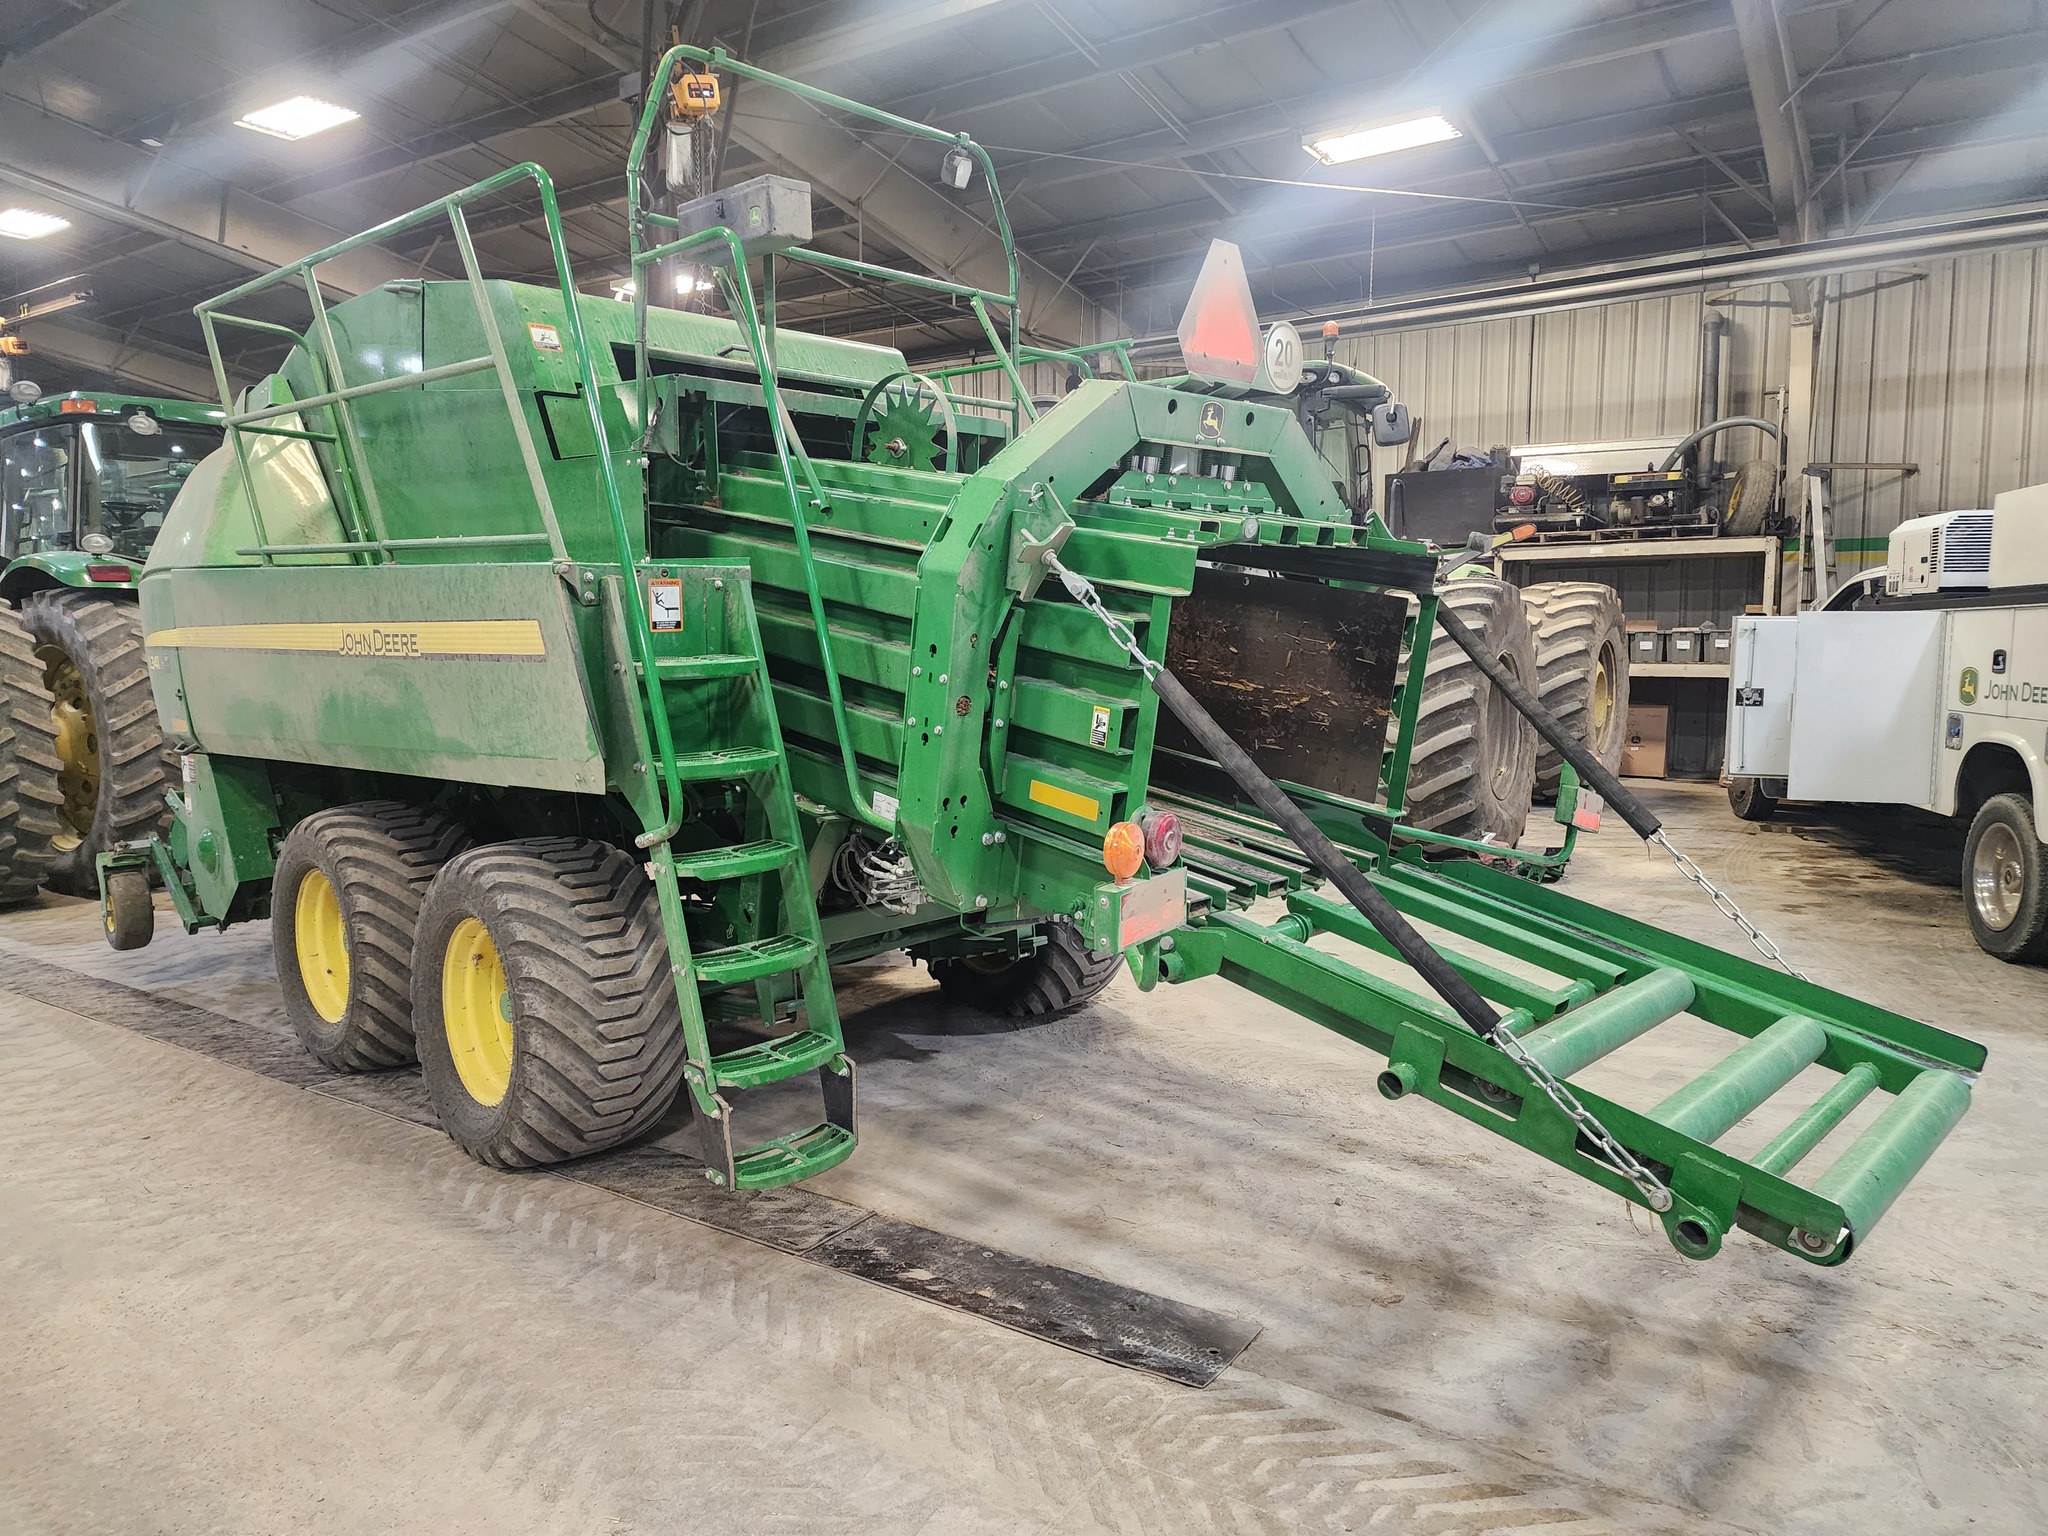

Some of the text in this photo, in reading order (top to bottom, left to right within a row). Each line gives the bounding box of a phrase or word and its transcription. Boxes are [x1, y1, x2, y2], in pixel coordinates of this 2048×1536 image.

[1274, 338, 1293, 368] 20
[339, 629, 419, 653] JOHN DEERE
[1984, 680, 2019, 701] JOHN
